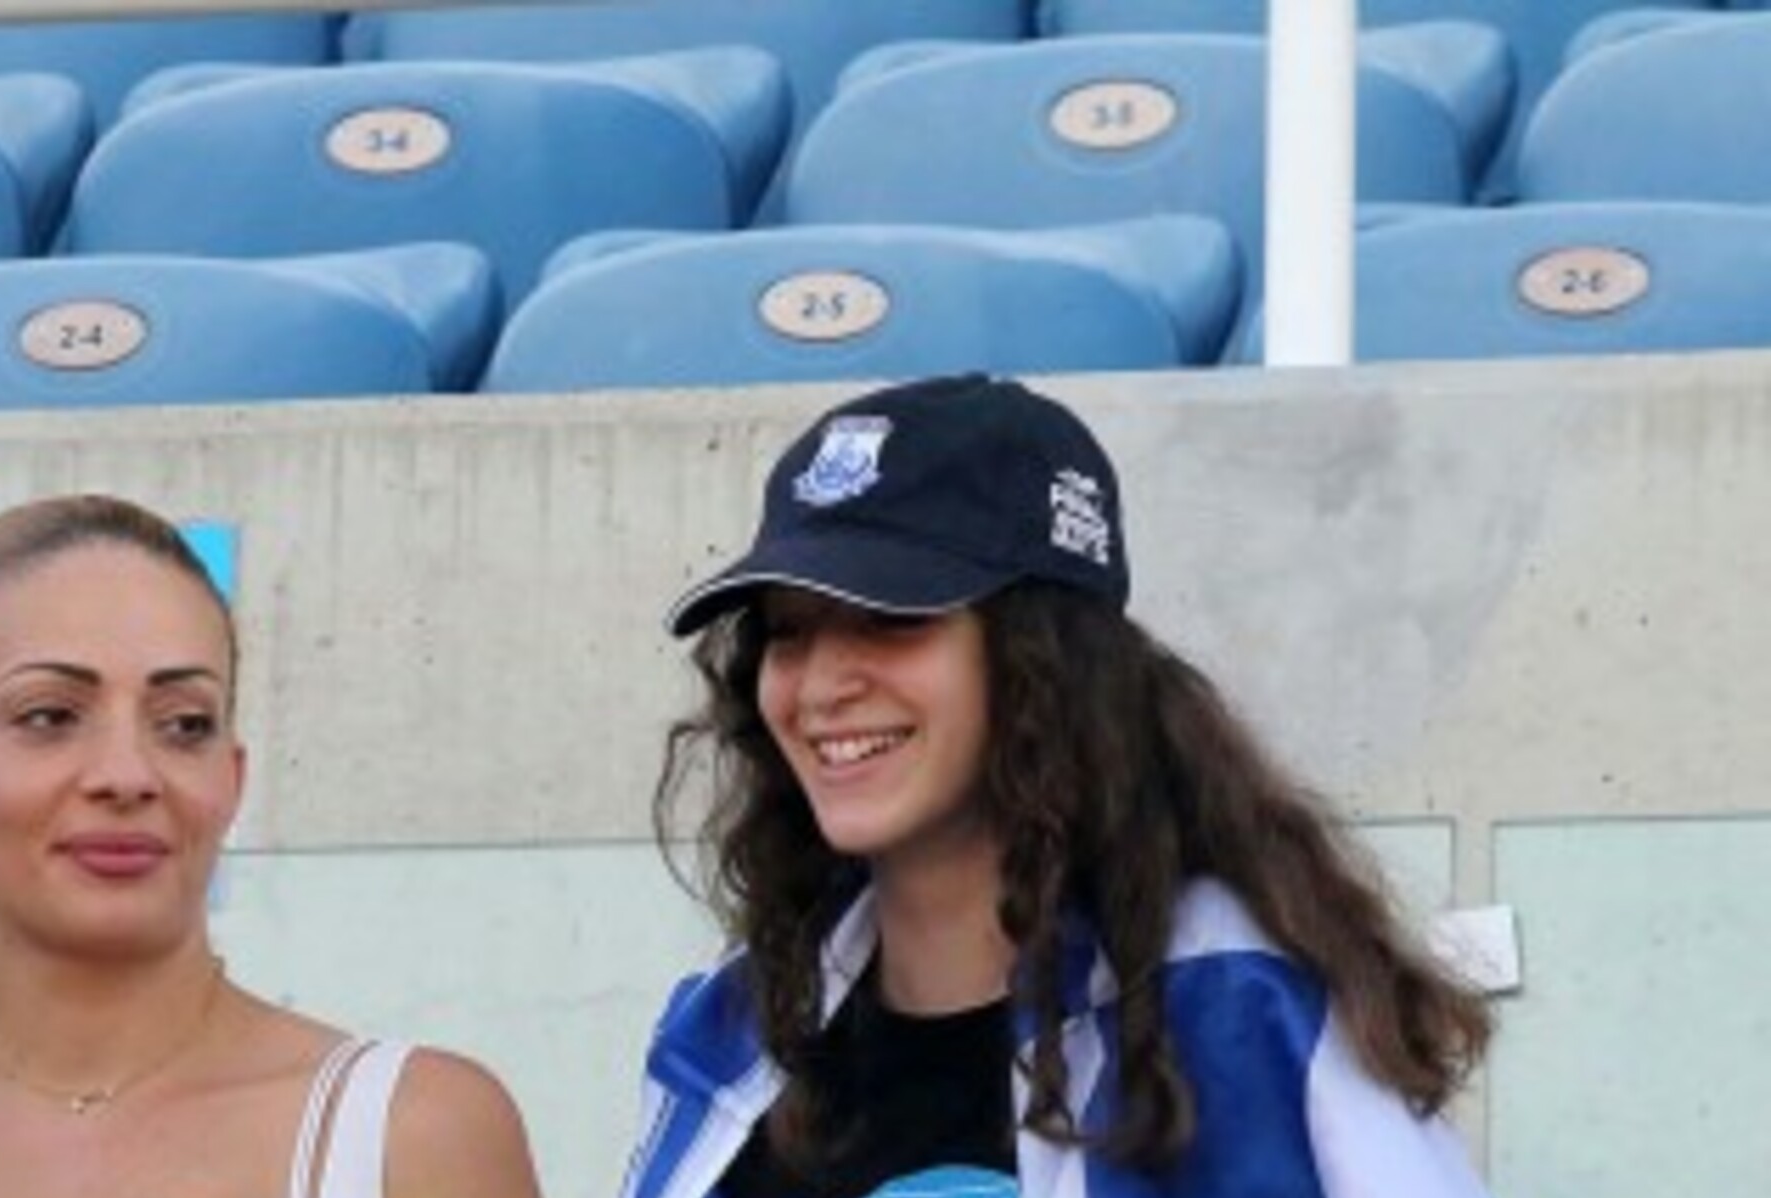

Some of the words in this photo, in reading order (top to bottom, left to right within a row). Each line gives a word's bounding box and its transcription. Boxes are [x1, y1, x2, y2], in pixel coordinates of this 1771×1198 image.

[1561, 269, 1607, 296] 2-6
[800, 291, 845, 320] 2-5
[59, 322, 104, 350] 2-4
